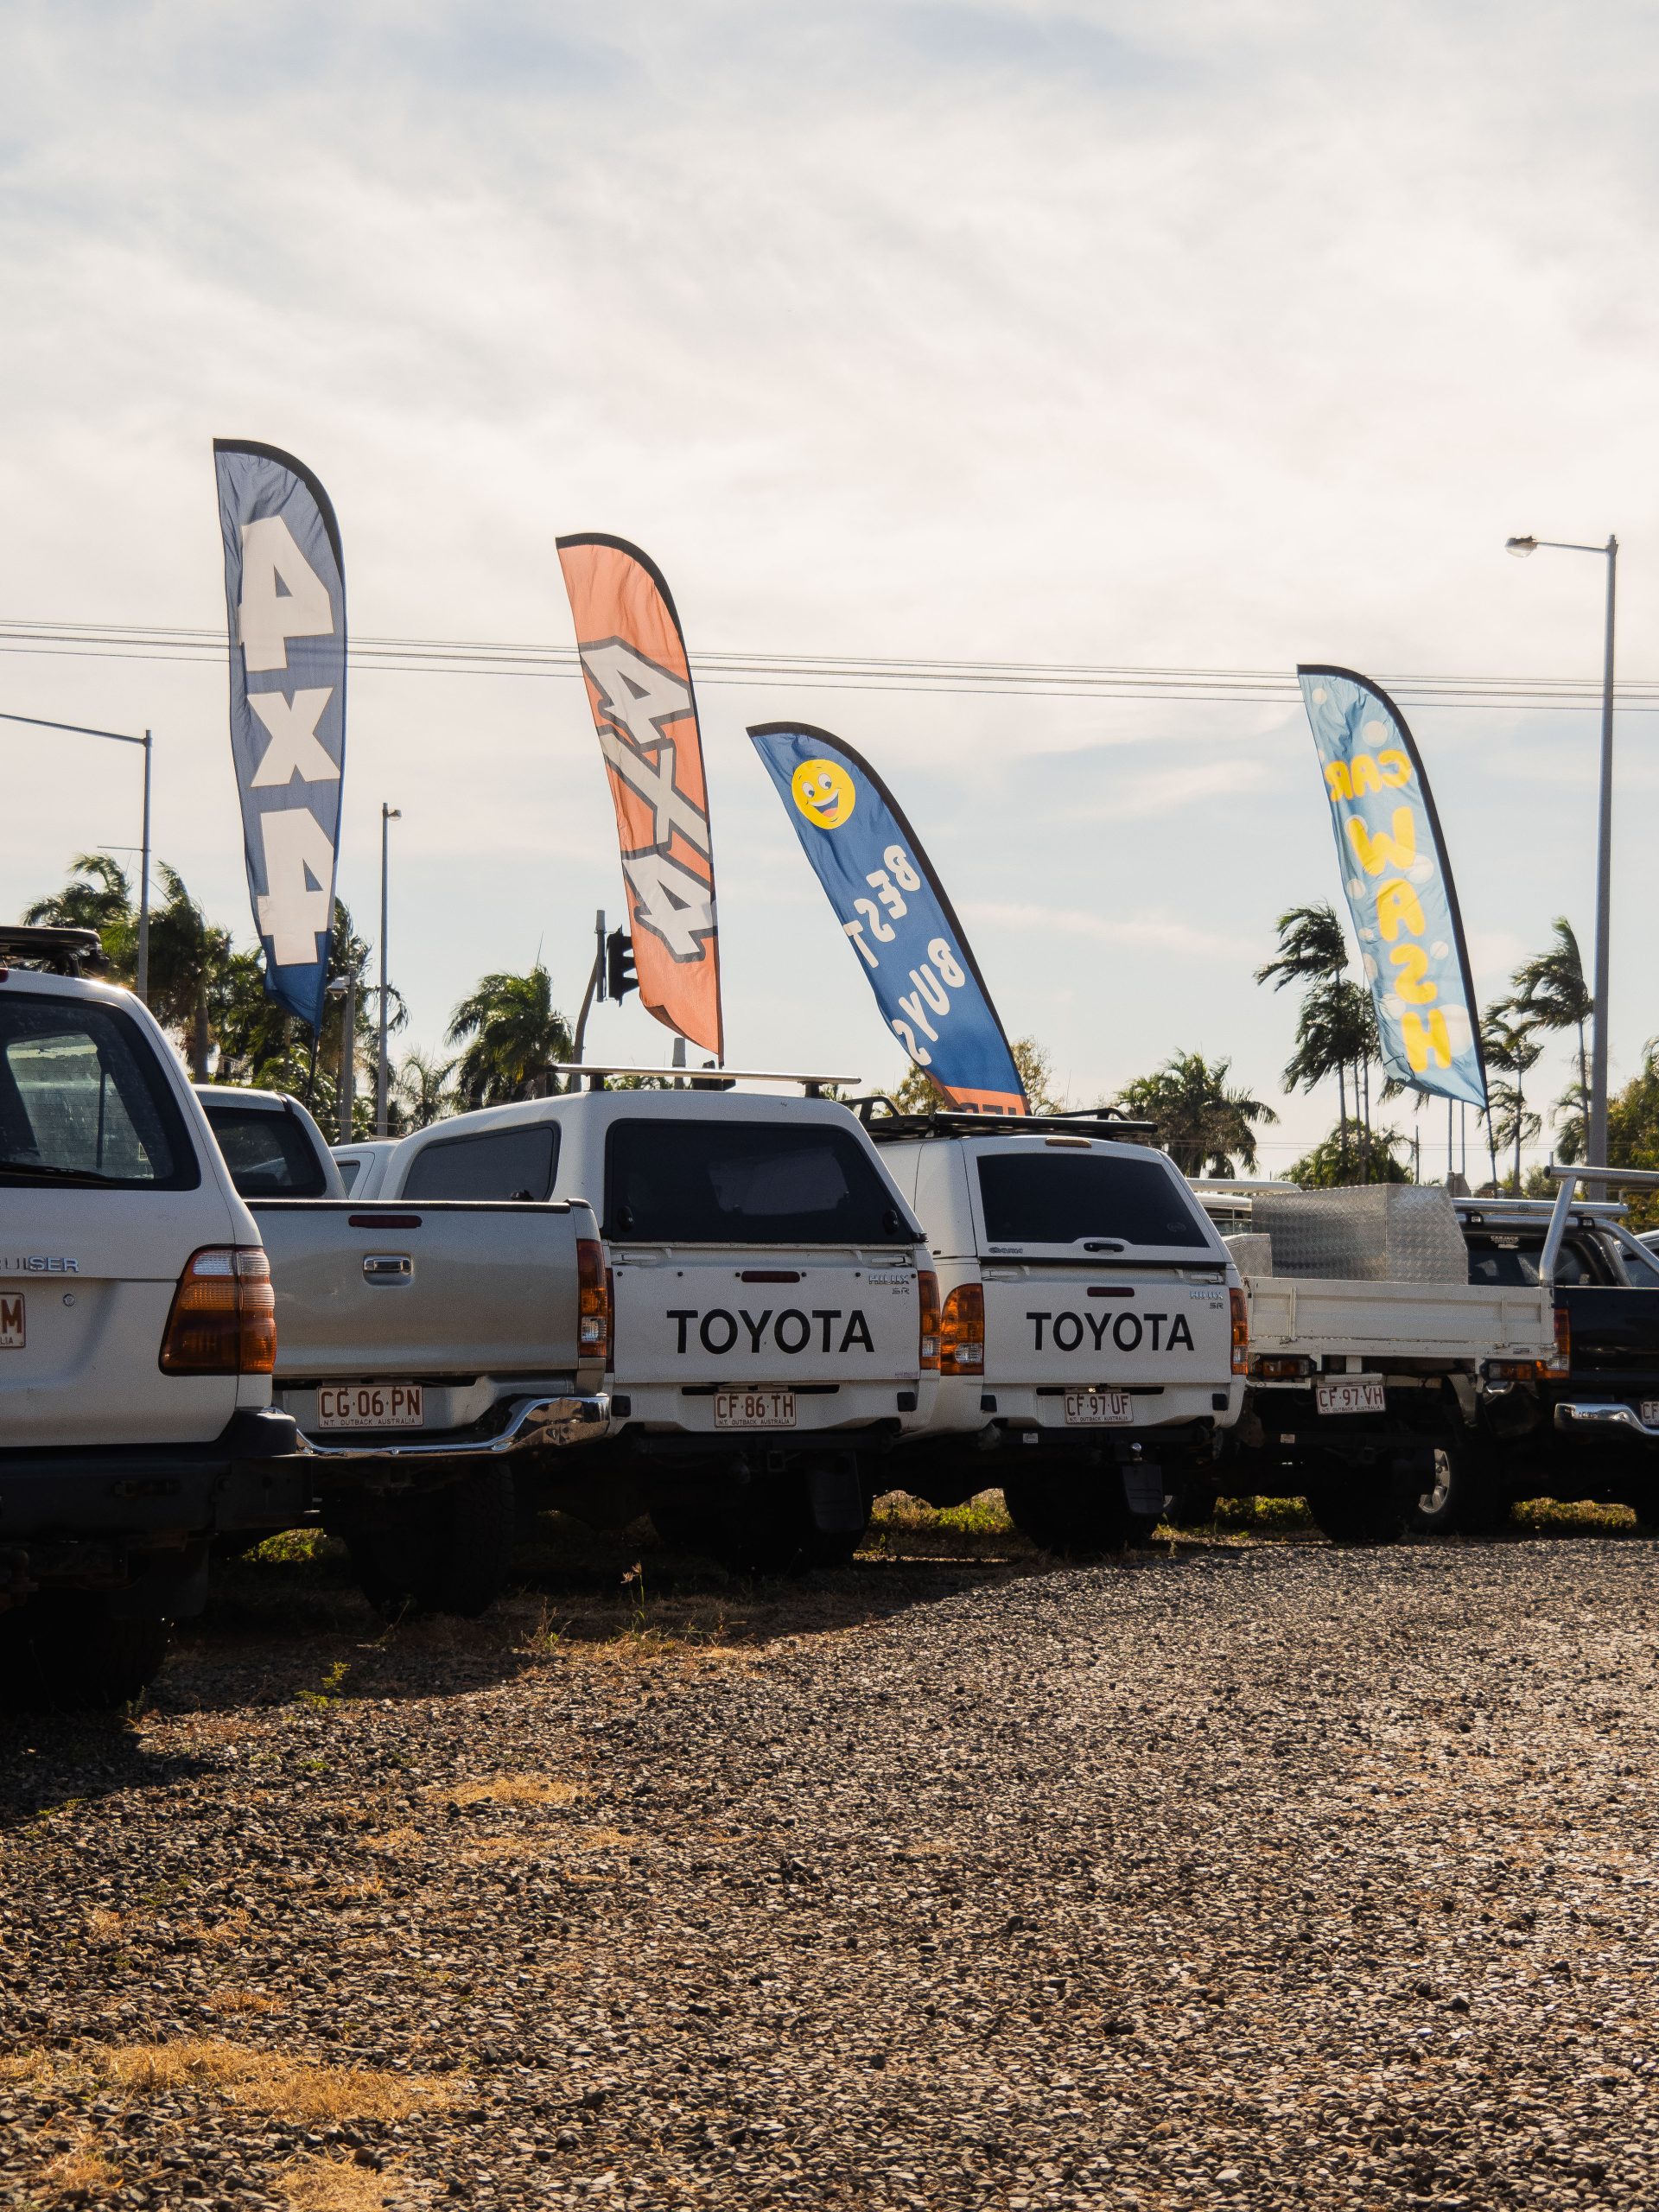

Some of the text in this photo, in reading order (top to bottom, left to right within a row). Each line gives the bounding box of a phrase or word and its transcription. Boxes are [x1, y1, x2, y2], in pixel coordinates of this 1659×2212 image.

[0, 1255, 79, 1273] UISER
[868, 1274, 910, 1285] HILUX
[892, 1287, 910, 1295] SR
[1189, 1290, 1224, 1300] HILUX
[666, 1308, 874, 1354] TOYOTA
[1026, 1311, 1195, 1351] TOYOTA
